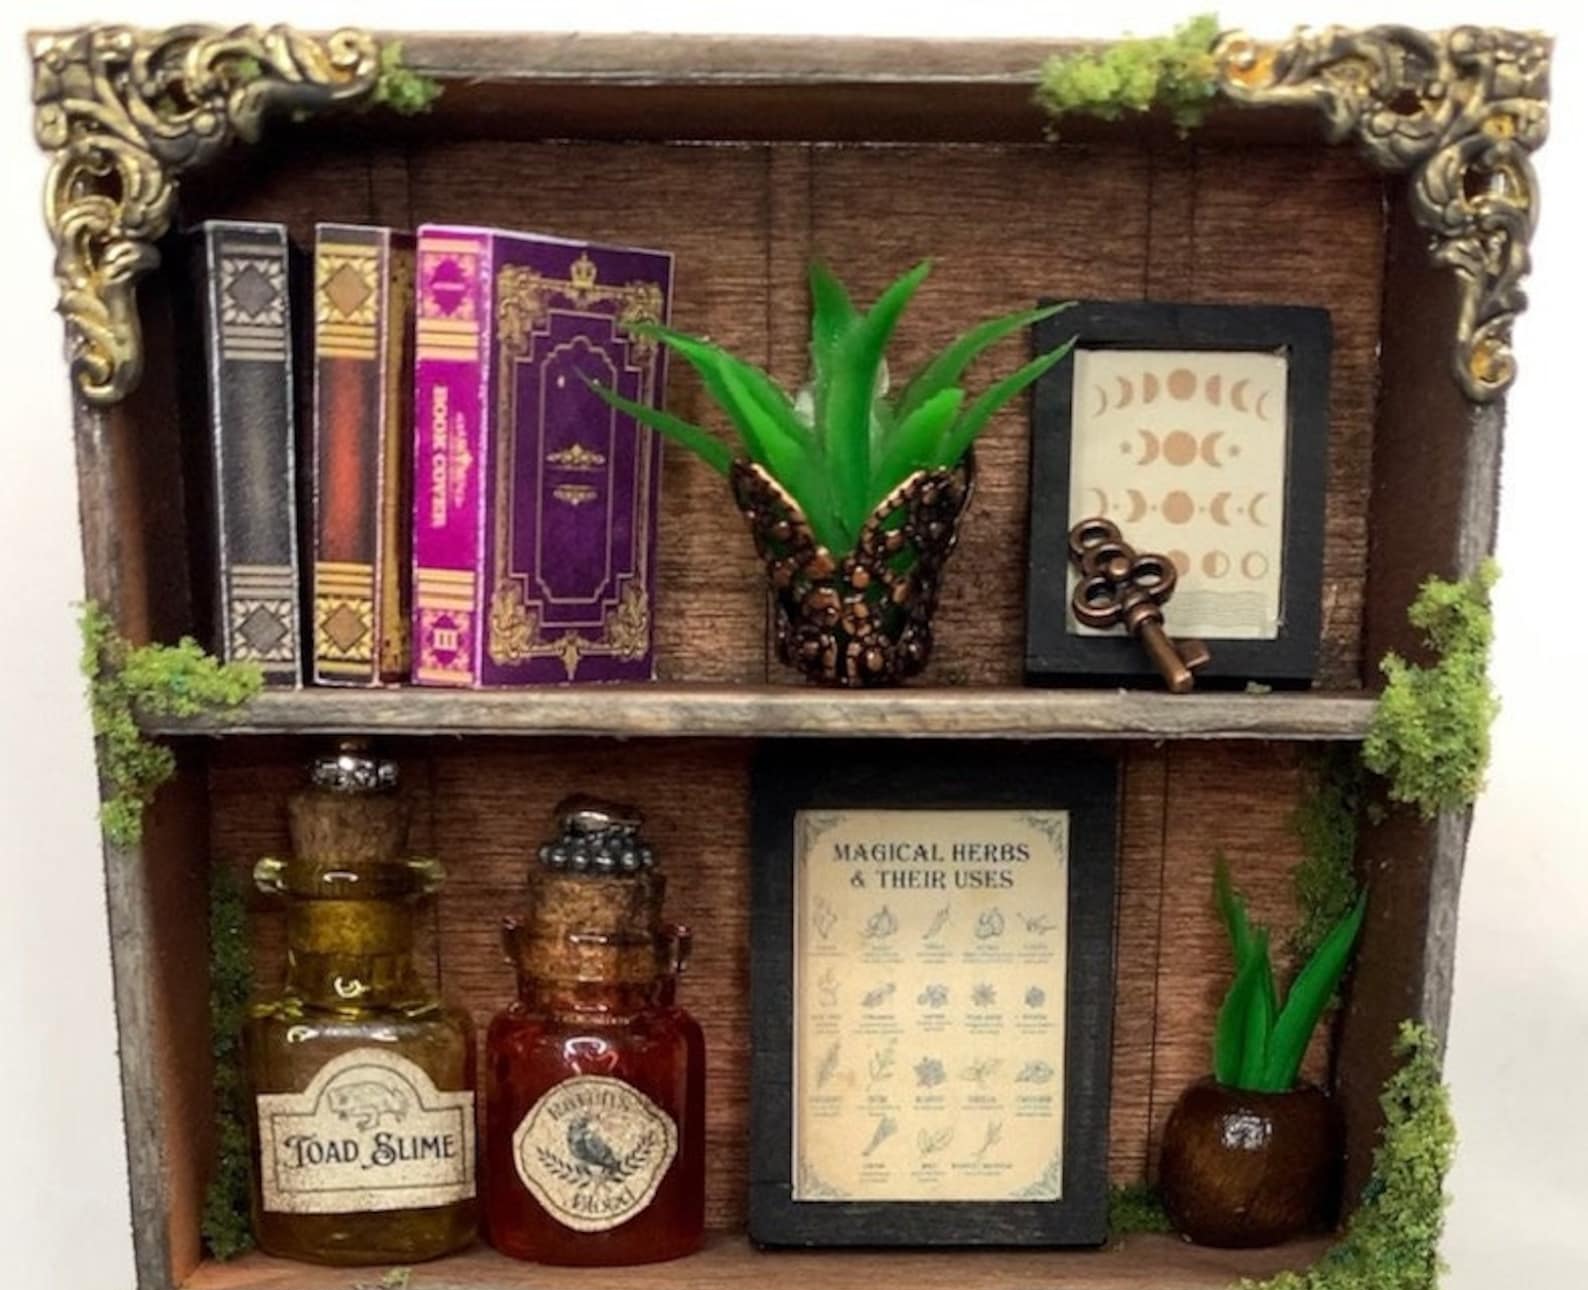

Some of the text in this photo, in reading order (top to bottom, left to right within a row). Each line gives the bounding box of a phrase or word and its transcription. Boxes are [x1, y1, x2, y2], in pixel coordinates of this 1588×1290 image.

[833, 842, 1031, 863] MAGICAL HERBS
[850, 869, 1015, 890] & THEIR USES
